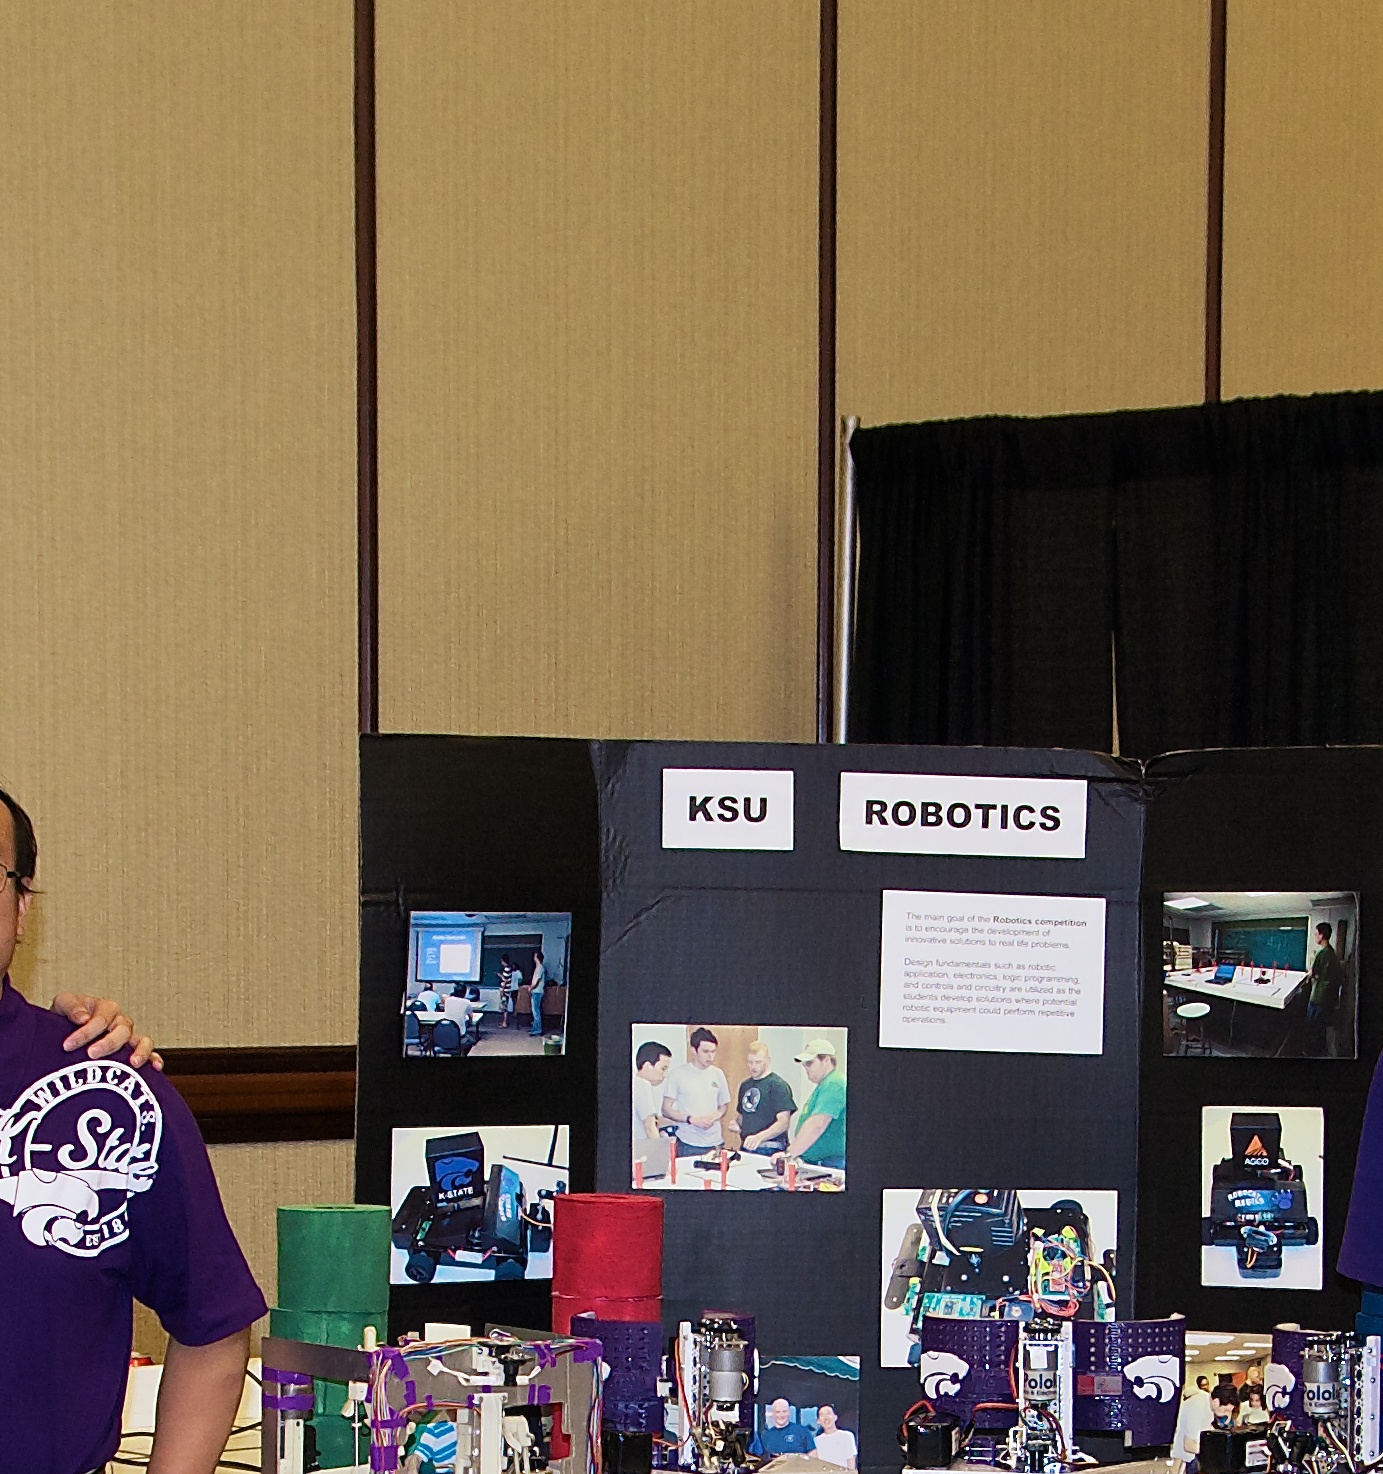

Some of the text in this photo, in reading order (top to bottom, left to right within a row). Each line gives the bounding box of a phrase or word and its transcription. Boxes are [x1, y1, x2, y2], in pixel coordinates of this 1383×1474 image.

[688, 795, 1062, 833] KSU ROBOTICS
[906, 911, 1087, 927] The main goal of the Robotics competition
[906, 924, 912, 932] is
[925, 926, 968, 935] encourage
[971, 926, 984, 934] the
[987, 928, 1040, 937] development
[1042, 929, 1050, 937] of
[905, 936, 946, 944] innovative
[949, 938, 985, 946] solutions
[904, 958, 933, 968] Design
[936, 959, 991, 969] fundamentals
[994, 962, 1013, 970] such
[1003, 974, 1022, 982] logic
[922, 982, 954, 990] controls
[974, 984, 1006, 994] circuitry
[1025, 986, 1053, 994] utilized
[1068, 987, 1081, 995] the
[903, 993, 1078, 1006] students develop solutions where potential
[903, 1004, 1075, 1018] robotic equipment could perform repetitive
[28, 1066, 156, 1124] WILDCATS
[1244, 1158, 1269, 1166] AGCO
[439, 1186, 474, 1200] K-STATE
